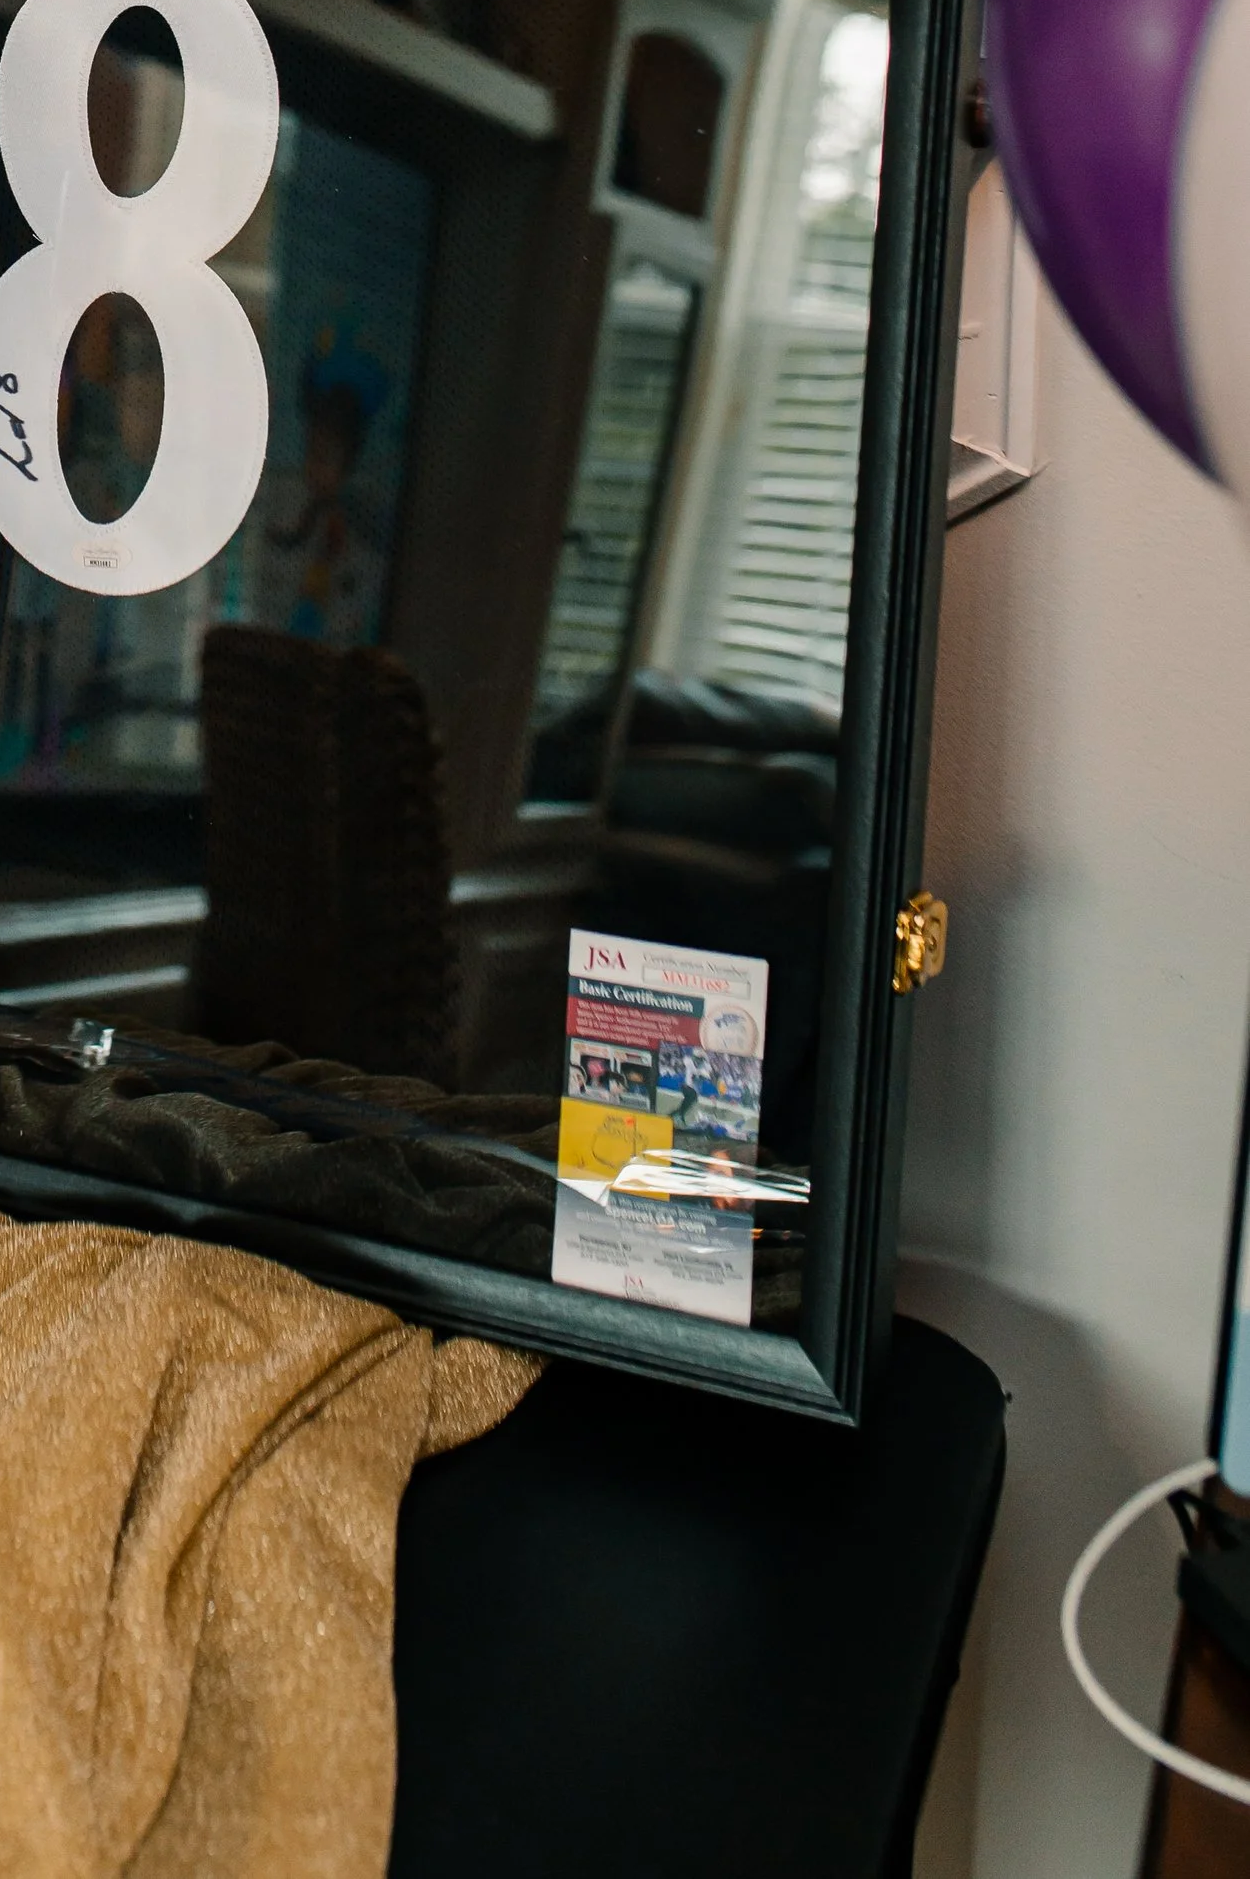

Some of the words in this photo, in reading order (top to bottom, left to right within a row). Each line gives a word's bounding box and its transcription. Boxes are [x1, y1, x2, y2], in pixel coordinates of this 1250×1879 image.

[583, 945, 628, 972] JSA
[578, 978, 611, 1000] Basic
[613, 985, 695, 1013] Certification
